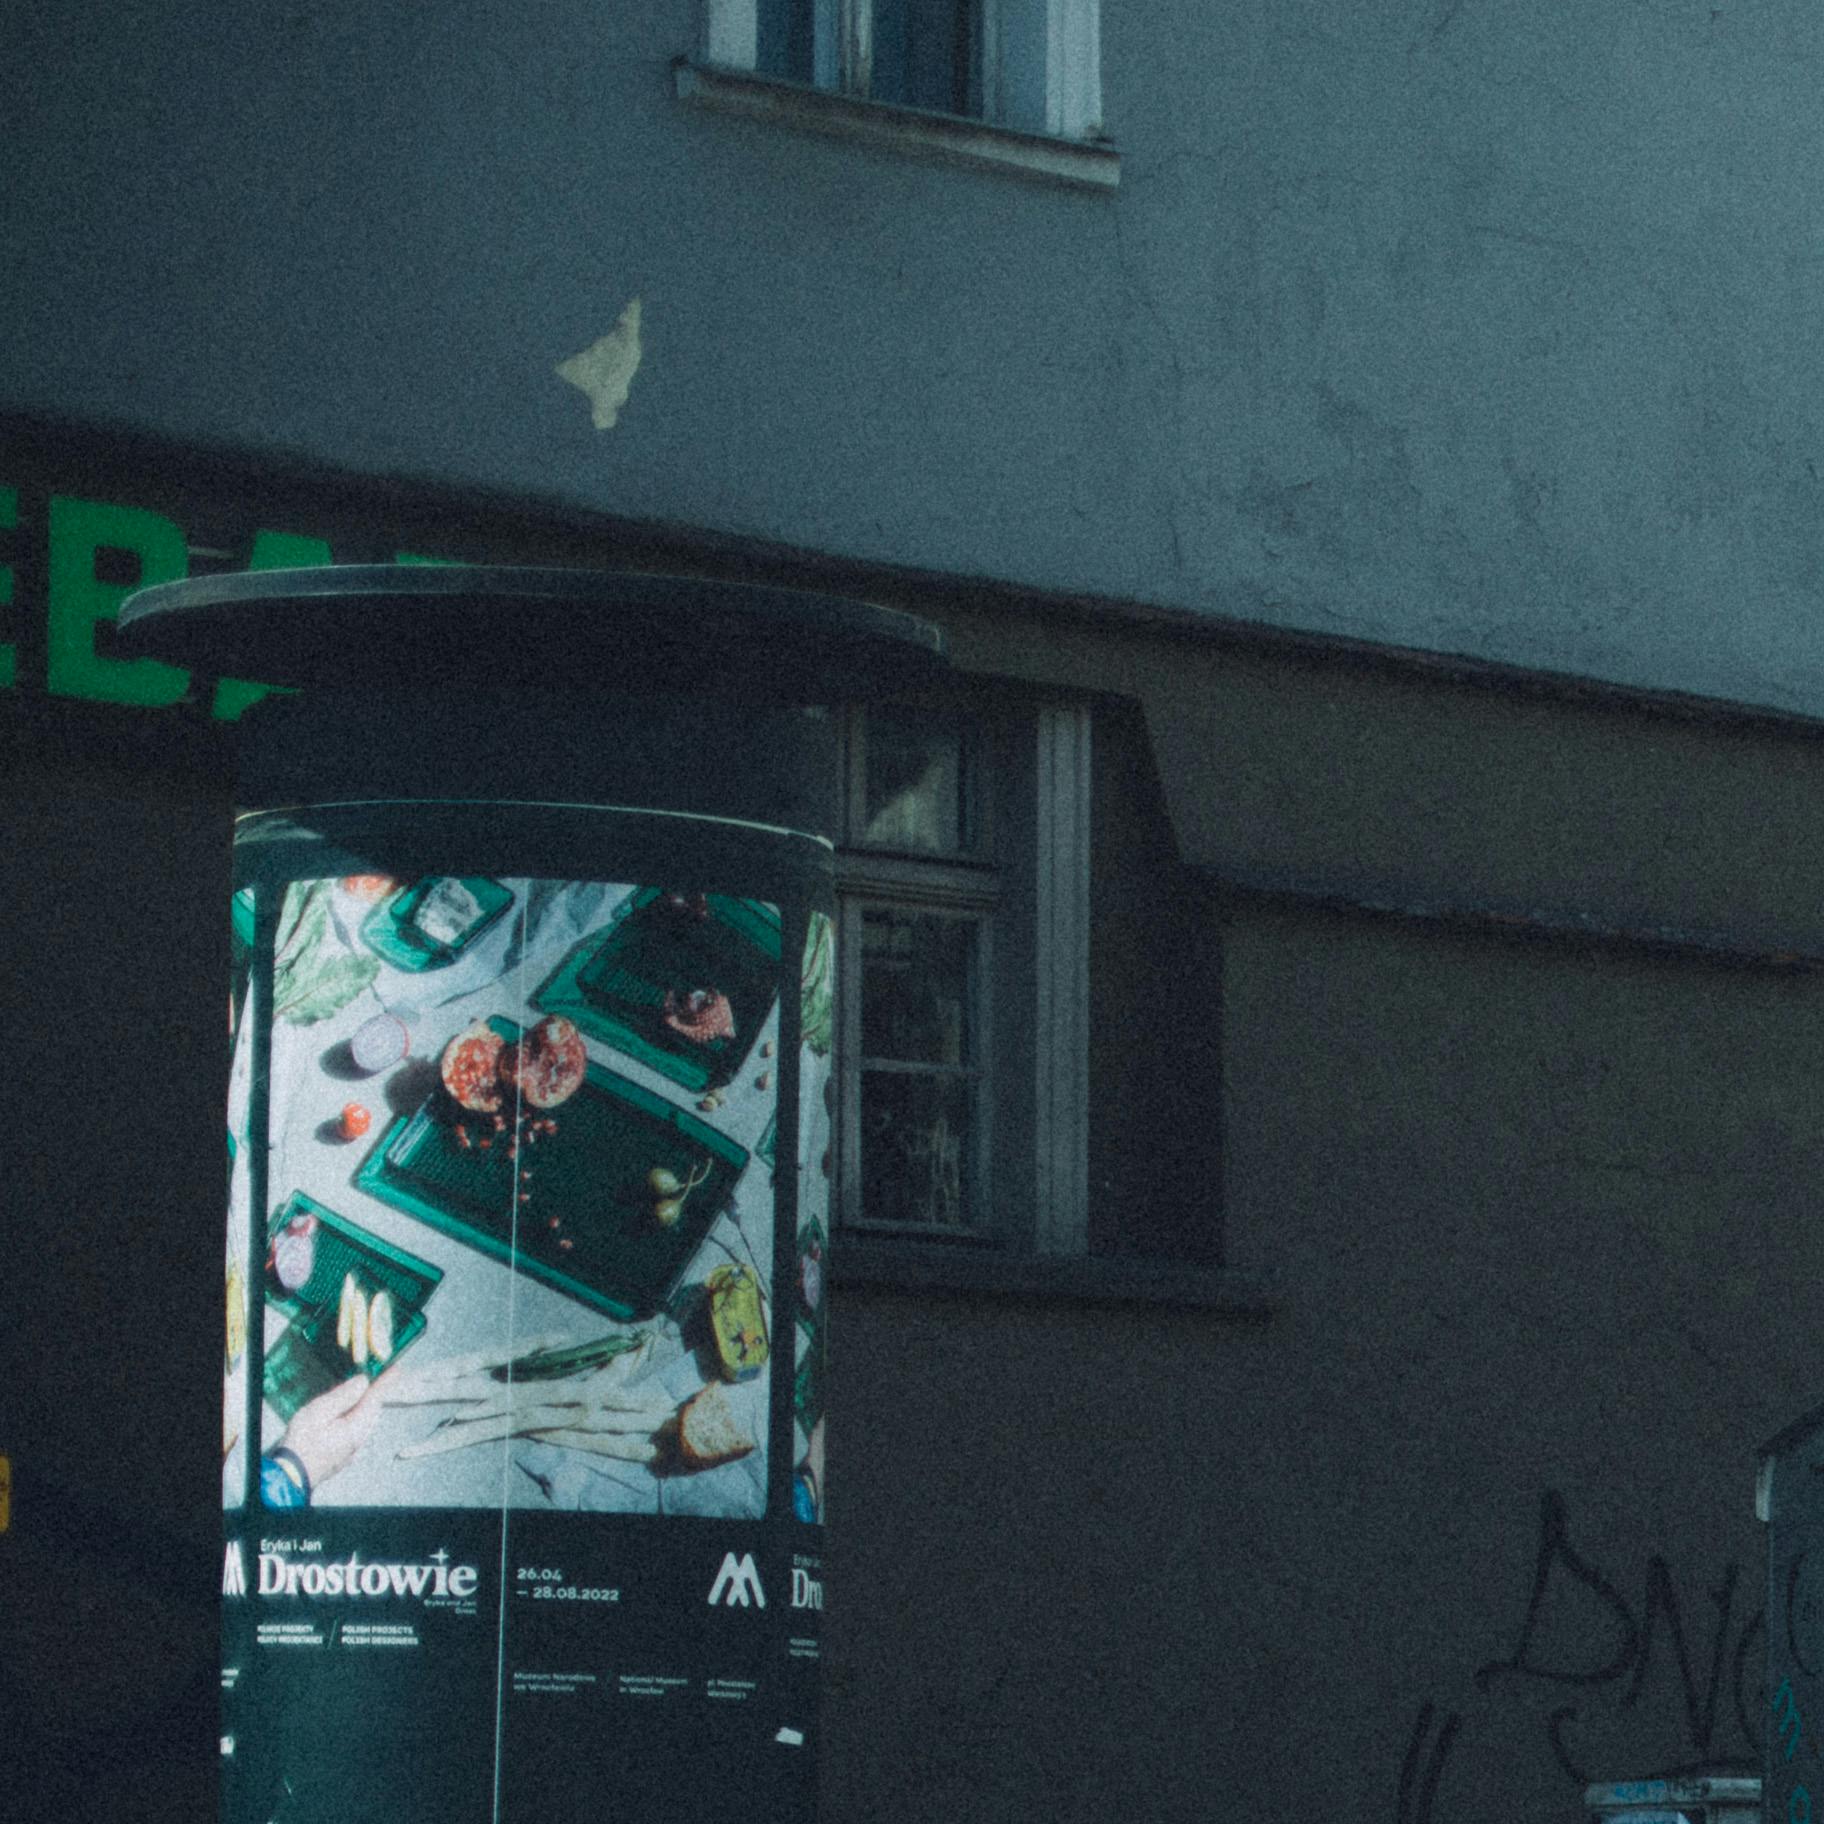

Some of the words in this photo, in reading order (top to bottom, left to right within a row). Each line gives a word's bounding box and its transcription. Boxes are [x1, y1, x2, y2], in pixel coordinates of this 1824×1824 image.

[258, 1548, 478, 1597] Drostowie
[516, 1567, 562, 1582] 26.04
[533, 1586, 619, 1601] 28.08.2022
